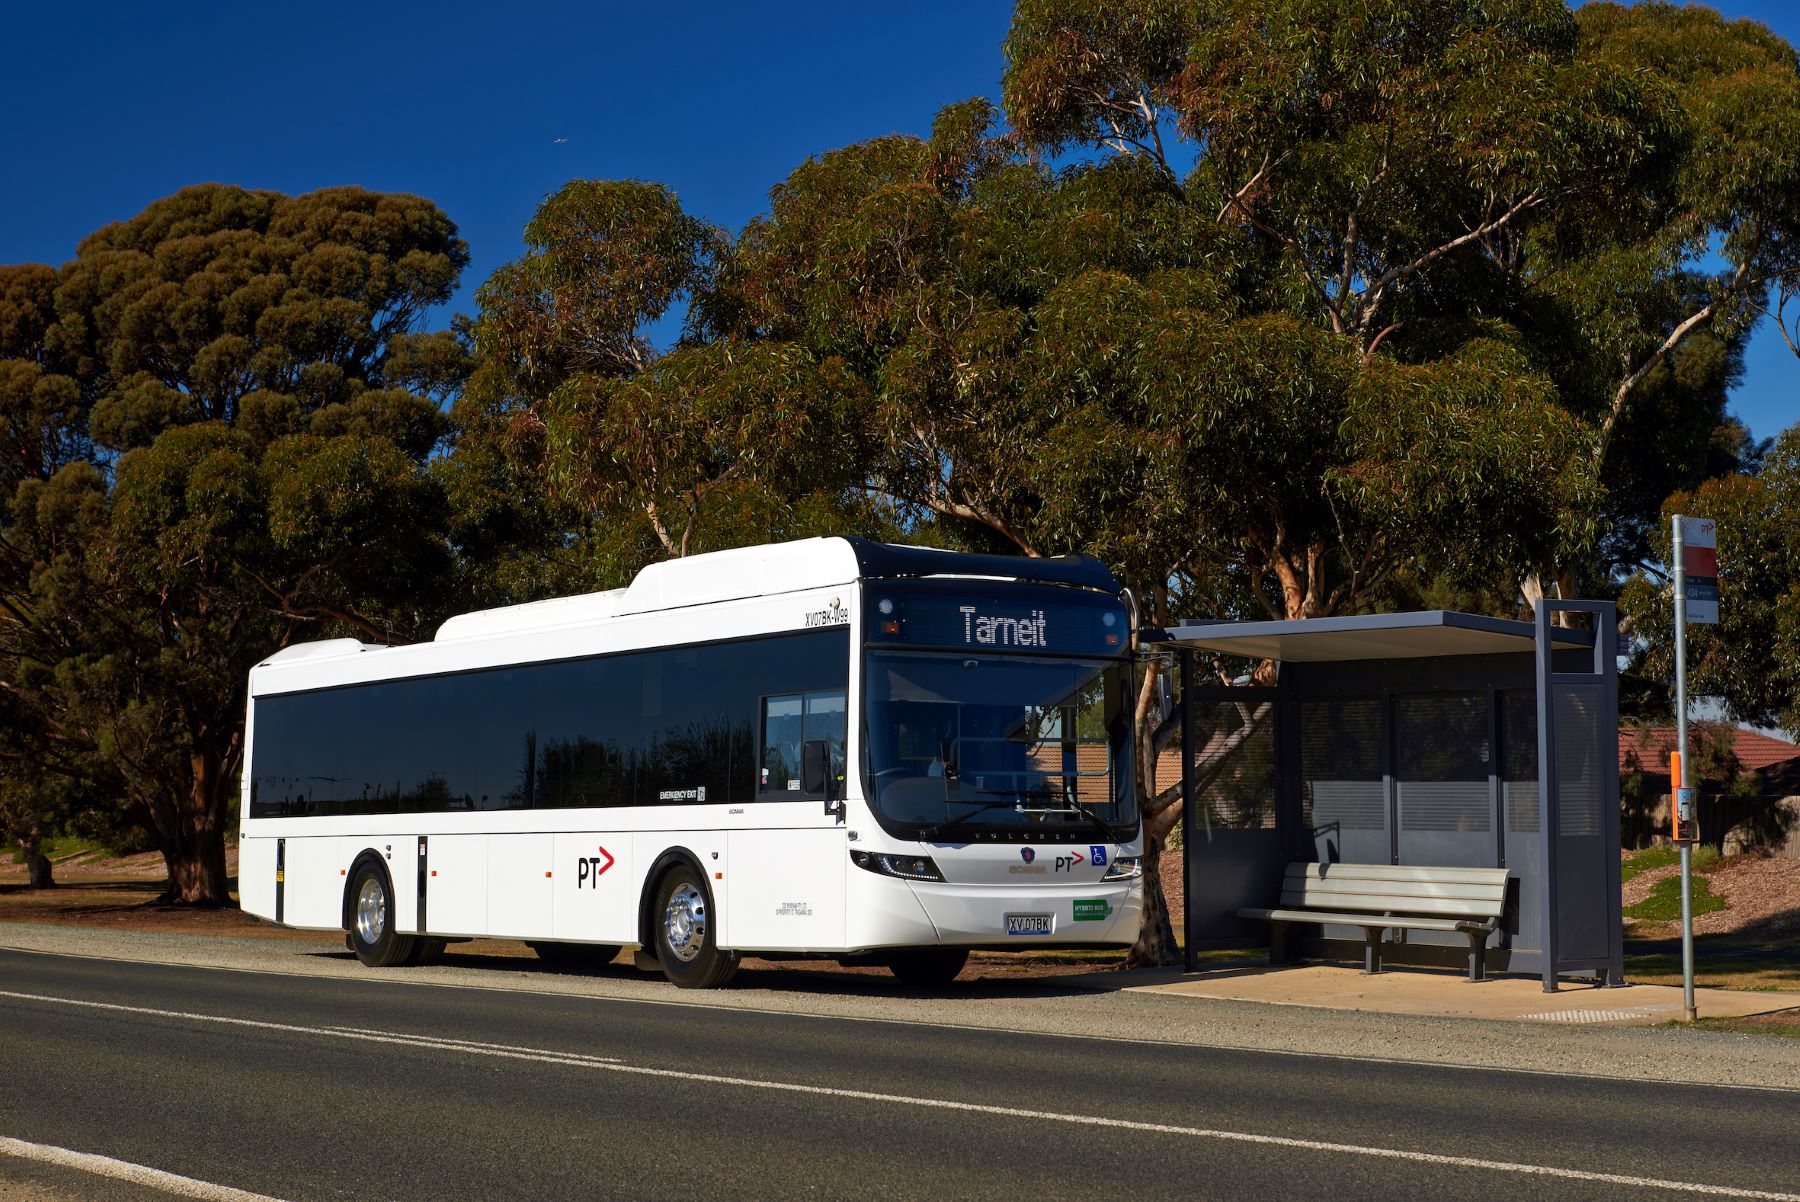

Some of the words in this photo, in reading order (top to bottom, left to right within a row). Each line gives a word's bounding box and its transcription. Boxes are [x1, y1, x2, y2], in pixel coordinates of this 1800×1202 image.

[805, 608, 849, 627] XV07BK-W99
[959, 606, 1047, 646] Tarneit
[659, 790, 687, 800] EMERGENCY
[687, 789, 697, 799] EXIT
